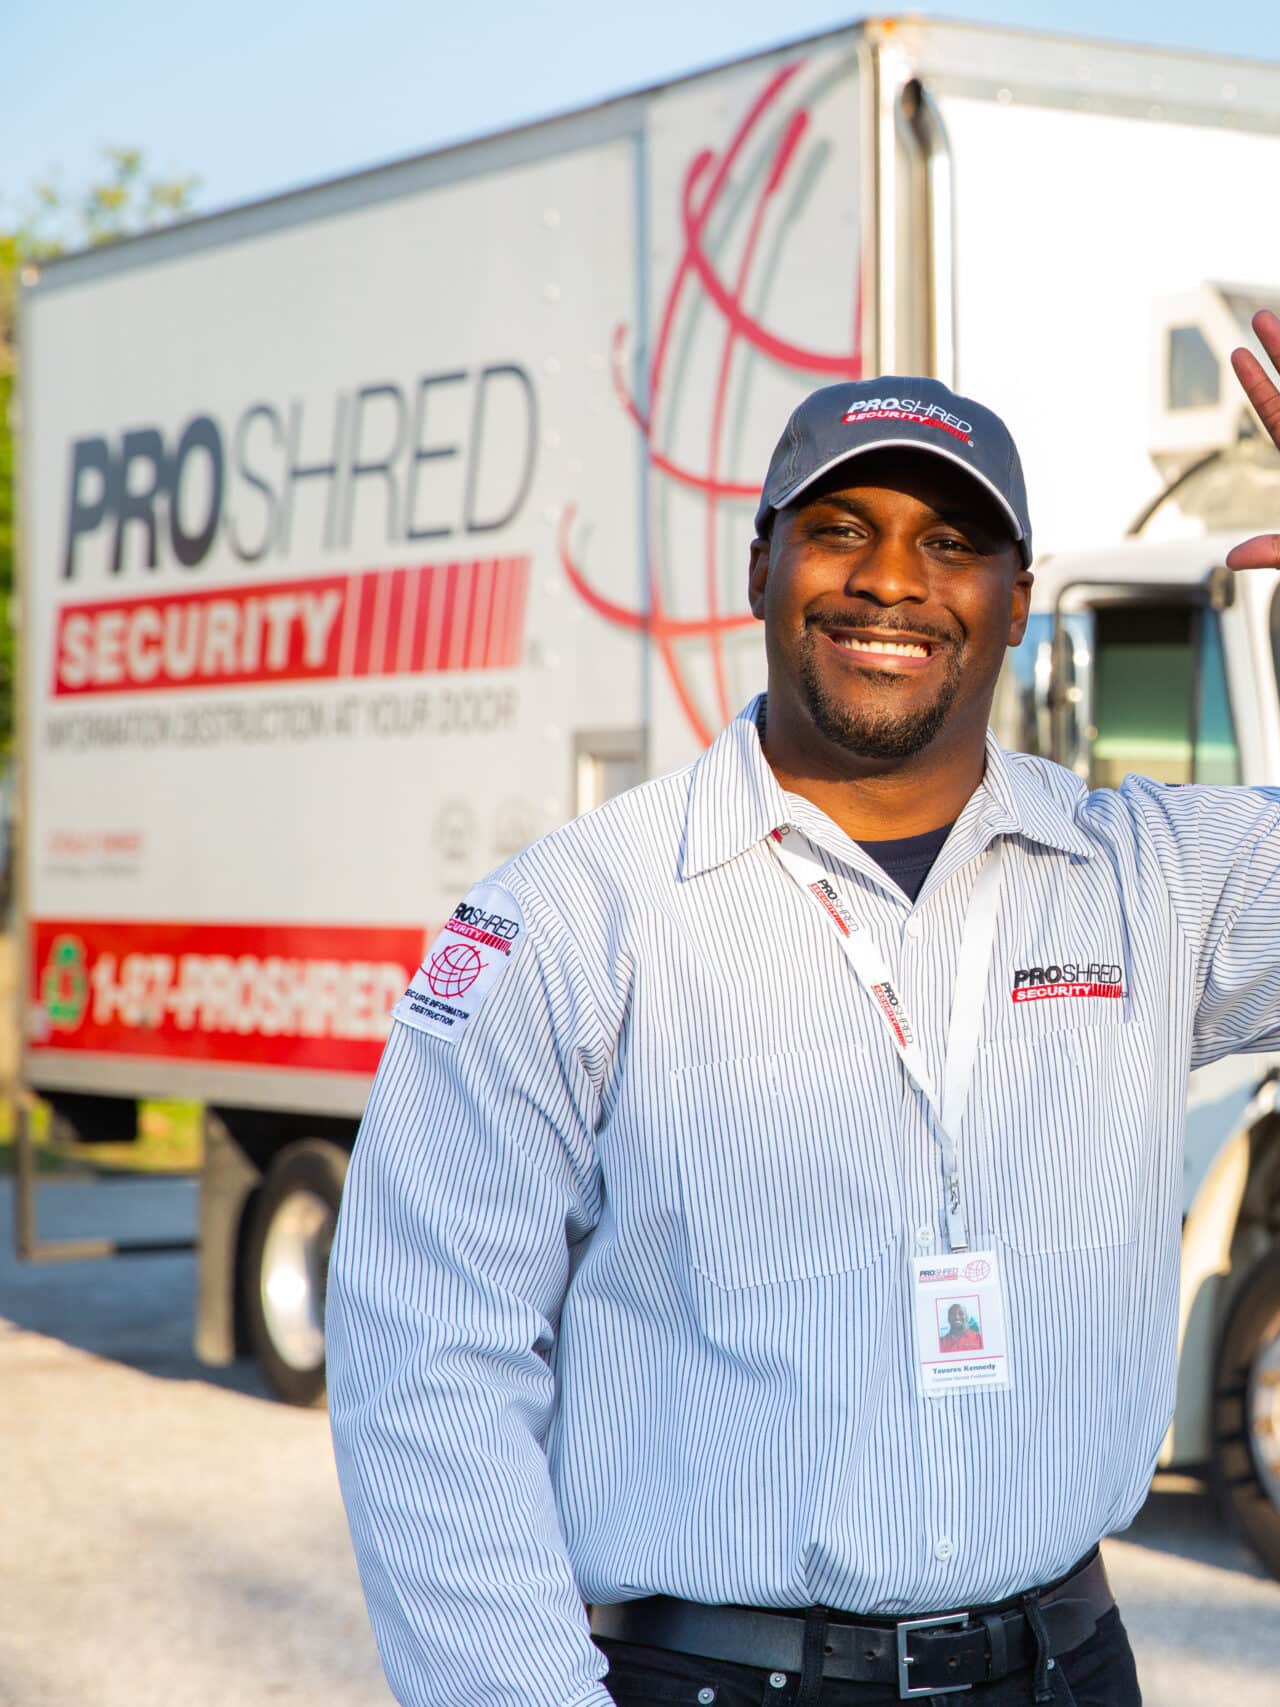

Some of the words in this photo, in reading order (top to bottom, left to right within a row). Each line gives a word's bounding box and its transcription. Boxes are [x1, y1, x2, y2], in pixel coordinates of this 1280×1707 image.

[846, 410, 930, 423] SECURITY
[847, 397, 973, 434] PROSHRED
[62, 362, 541, 580] PROSHRED
[59, 589, 343, 690] SECURITY
[447, 920, 482, 939] CURITY
[455, 902, 520, 940] ROSHRED
[1013, 963, 1122, 989] PROSHRED
[404, 988, 431, 1005] ECURE
[1016, 985, 1091, 1001] SECURITY
[409, 1002, 455, 1026] DESTRUCTION
